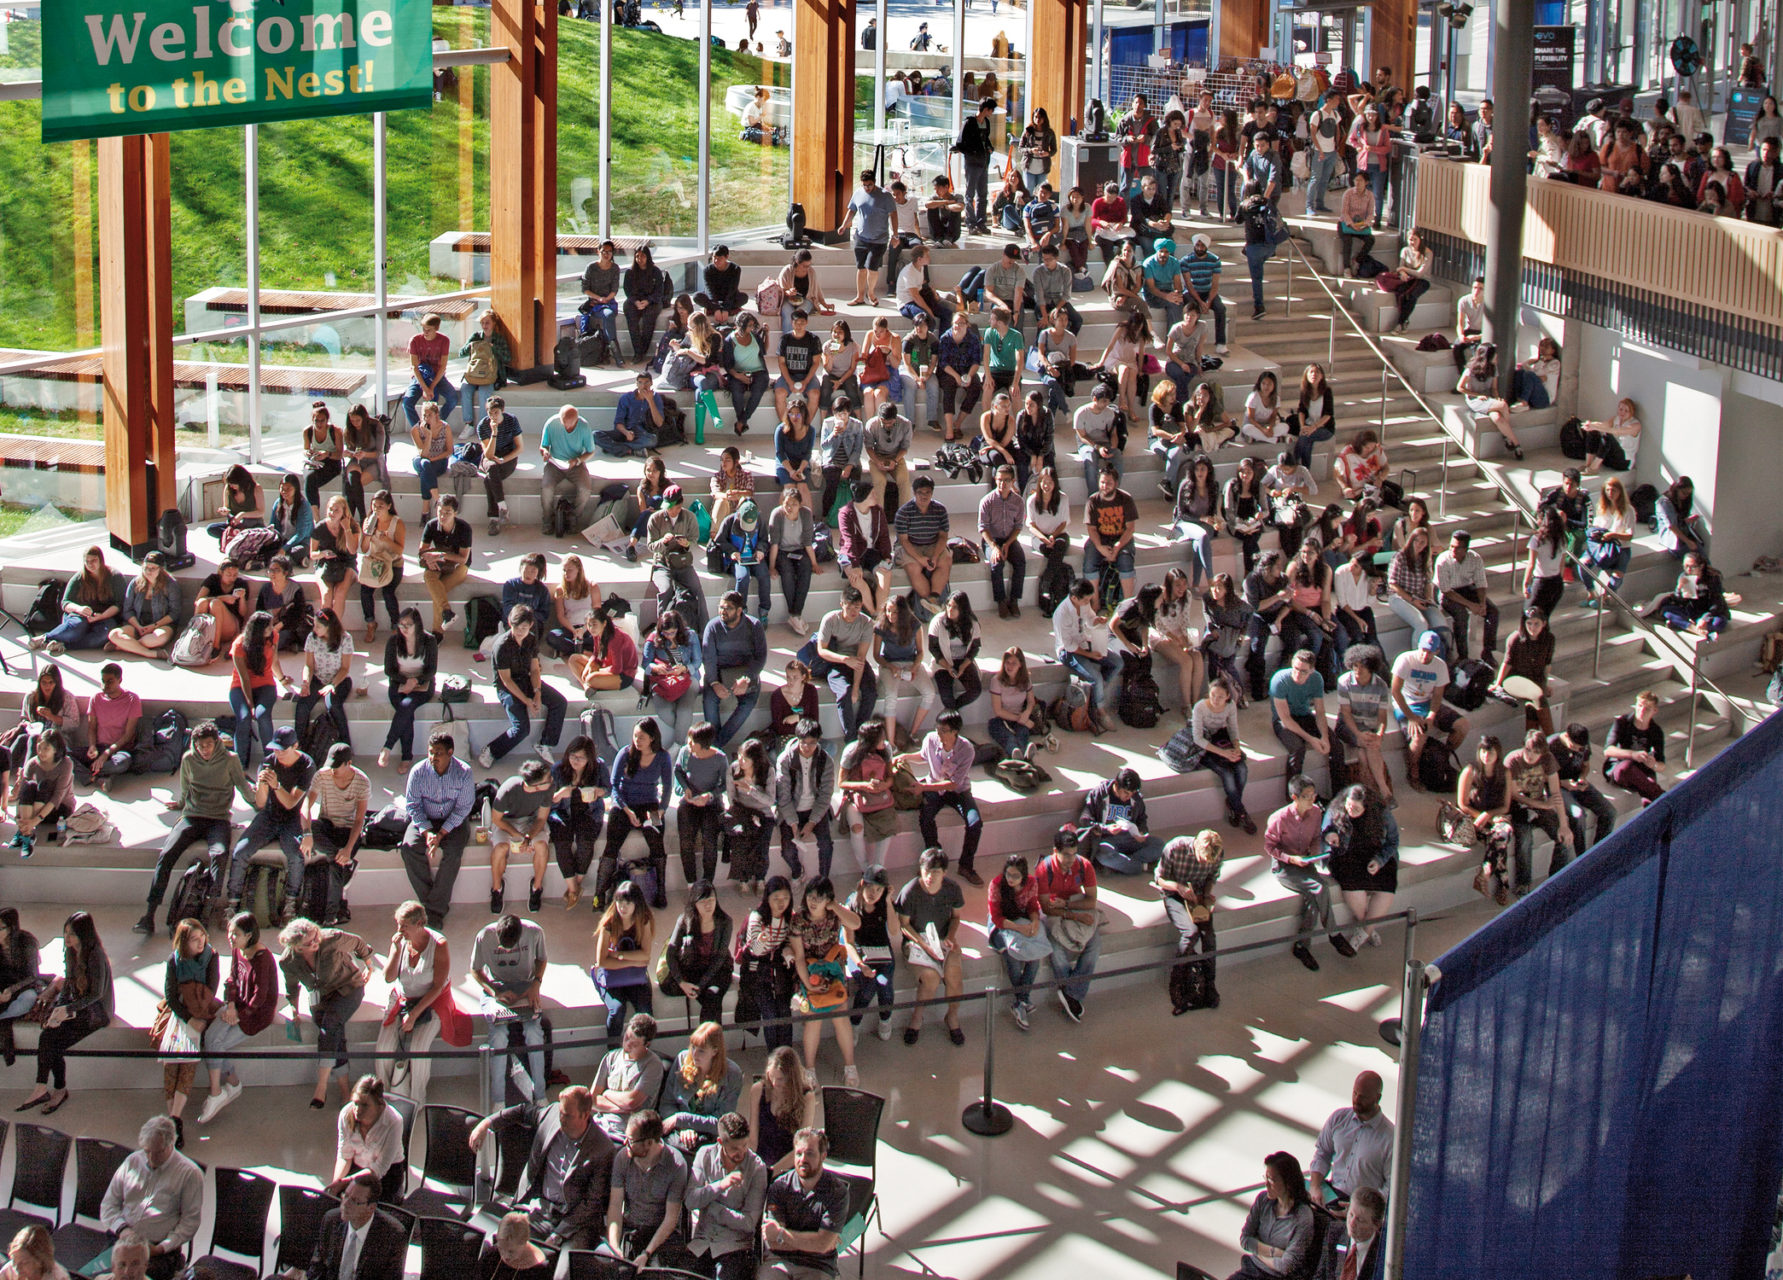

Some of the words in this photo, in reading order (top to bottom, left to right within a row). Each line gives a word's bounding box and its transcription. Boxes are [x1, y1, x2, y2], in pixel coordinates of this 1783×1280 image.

[84, 6, 393, 65] Welcome
[107, 82, 156, 114] to
[172, 71, 247, 109] the
[265, 60, 375, 101] Nest!
